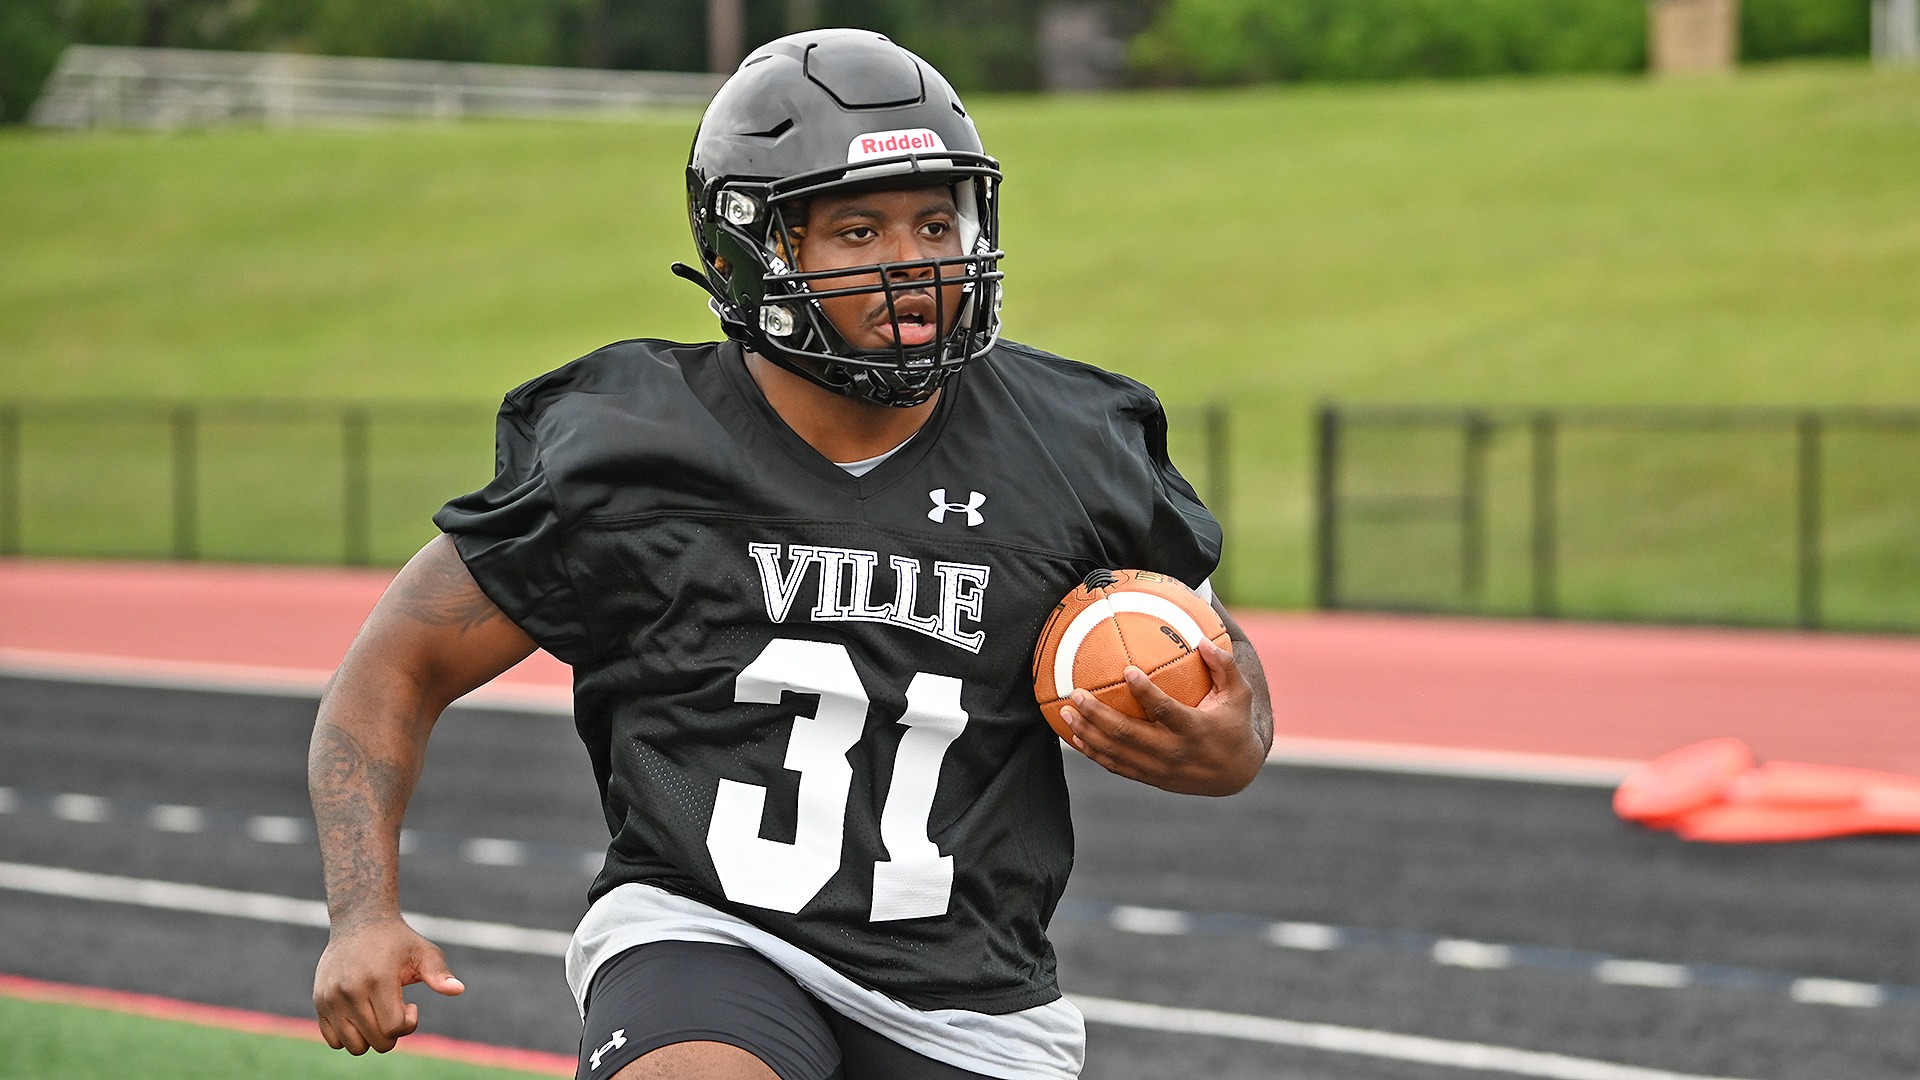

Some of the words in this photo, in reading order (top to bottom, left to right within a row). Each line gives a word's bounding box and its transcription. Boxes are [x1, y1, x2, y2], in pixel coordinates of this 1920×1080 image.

[861, 133, 935, 154] Riddell
[748, 541, 991, 655] VILLE
[705, 637, 970, 923] 31
